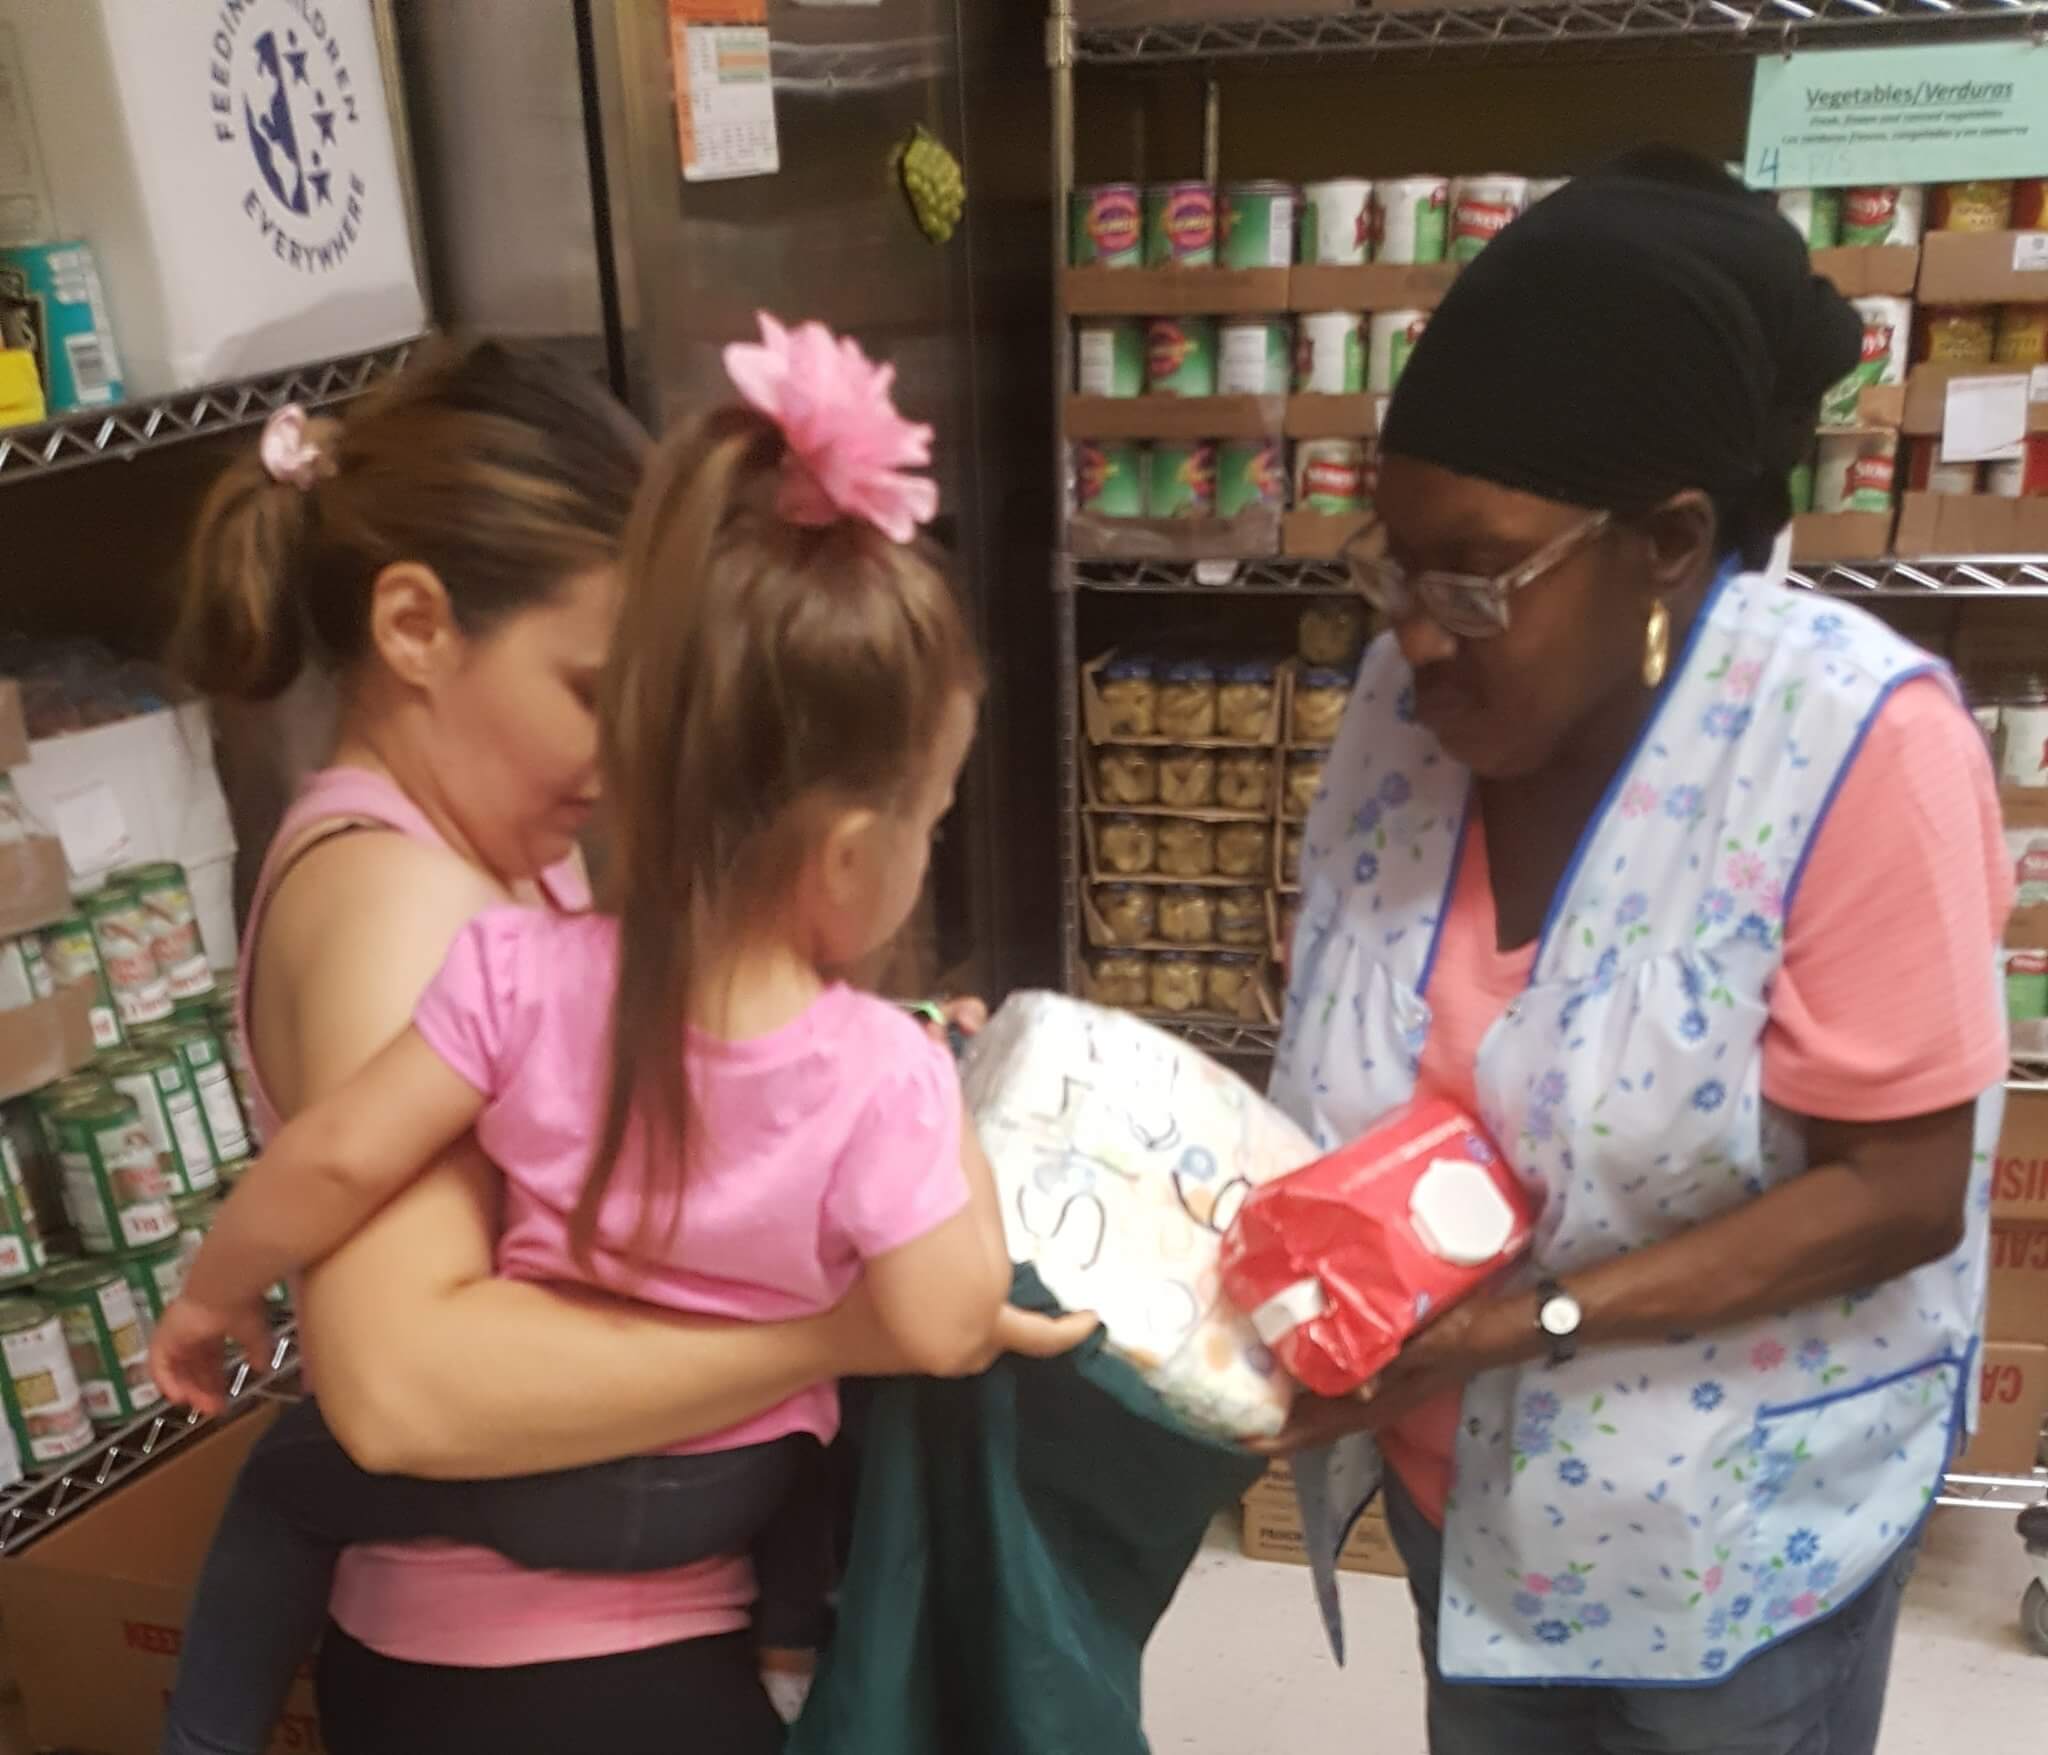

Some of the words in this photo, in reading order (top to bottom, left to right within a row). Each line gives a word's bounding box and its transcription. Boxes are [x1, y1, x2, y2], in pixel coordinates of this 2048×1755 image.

[210, 0, 255, 142] FEEDIN
[1806, 80, 2014, 107] Vegetables/Verduras
[243, 173, 365, 273] EVERYWHERE
